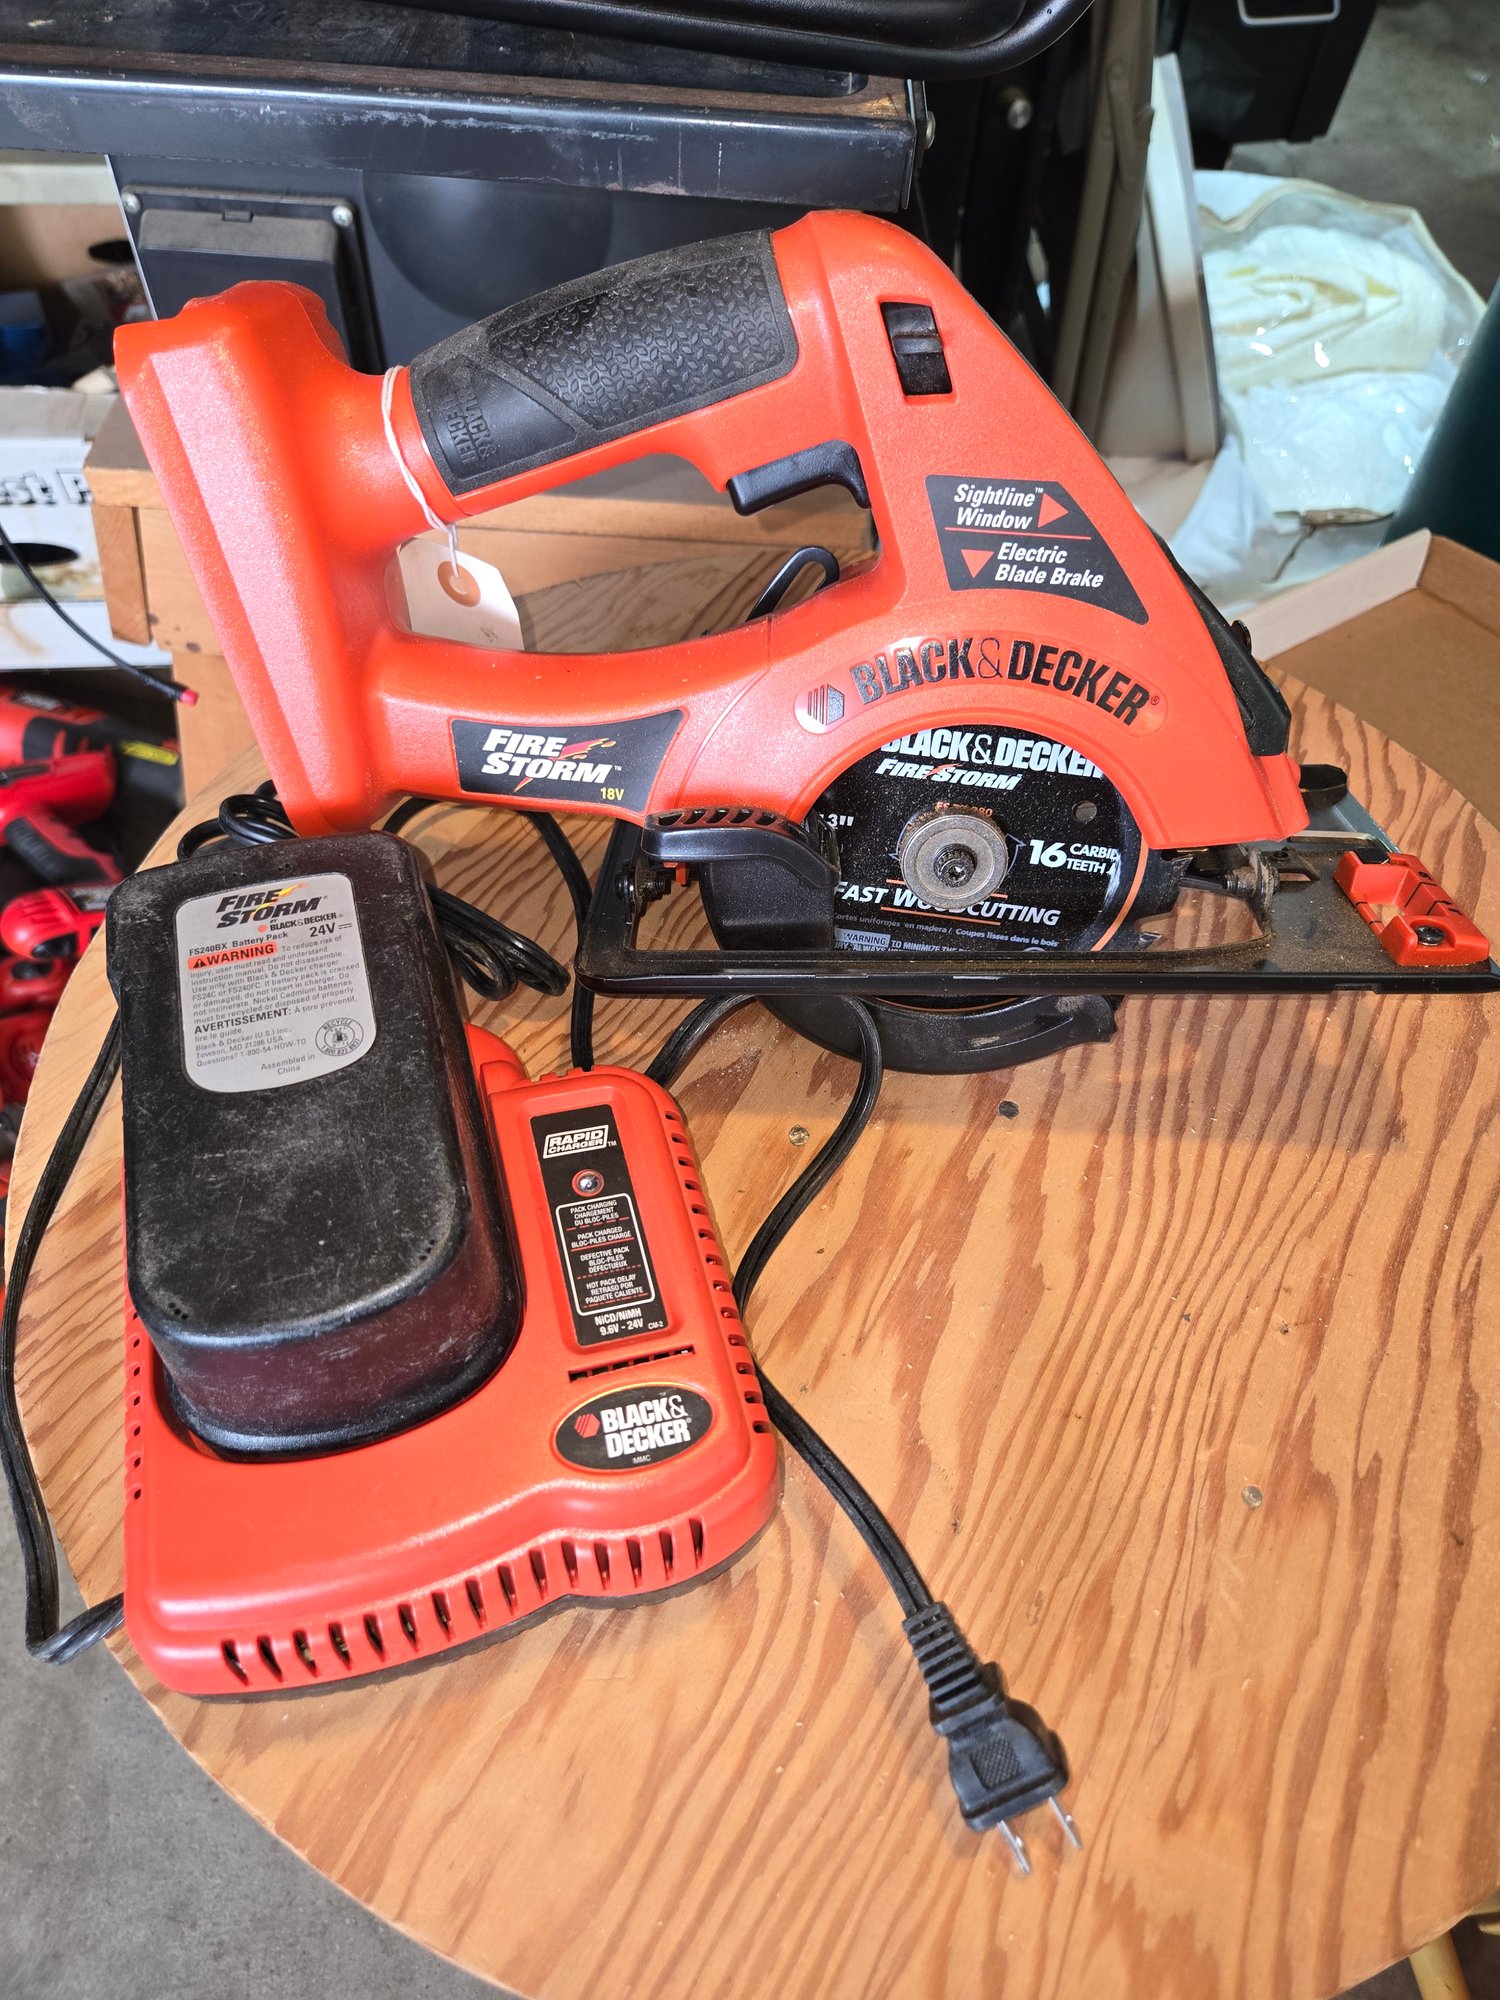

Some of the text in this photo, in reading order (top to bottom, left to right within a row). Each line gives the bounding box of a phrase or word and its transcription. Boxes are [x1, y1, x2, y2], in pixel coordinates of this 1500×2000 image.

[956, 507, 1033, 530] Window
[997, 542, 1068, 564] Electric
[995, 563, 1104, 588] Blade Brake
[482, 728, 568, 757] FIRE
[875, 758, 935, 779] FIRE
[600, 787, 625, 801] 18V
[1029, 839, 1067, 868] 16
[1066, 858, 1106, 874] TEETH
[216, 888, 282, 913] FIRE
[834, 881, 888, 904] FAST
[216, 896, 322, 929] STORM
[309, 922, 336, 938] 24V
[860, 916, 900, 927] uniformes
[916, 924, 947, 934] madera
[955, 928, 985, 938] Coupes
[987, 932, 1009, 940] lisses
[1010, 935, 1029, 944] dans
[1031, 937, 1039, 945] le
[1040, 939, 1058, 947] bois
[189, 931, 288, 956] FS240BX Battery Pack
[207, 944, 274, 966] WARNING
[293, 941, 318, 950] reduce
[320, 936, 332, 945] risk
[891, 940, 902, 949] TO
[234, 961, 252, 969] must
[254, 957, 271, 965] read
[274, 955, 286, 963] and
[288, 947, 328, 959] understand
[191, 986, 207, 994] Use
[210, 982, 226, 990] only
[228, 978, 245, 986] with
[247, 973, 269, 983] Black
[280, 966, 307, 976] Decker
[309, 960, 339, 971] charger
[191, 974, 233, 986] instruction
[192, 991, 217, 1001] FS24C
[272, 975, 299, 985] battery
[301, 970, 318, 980] pack
[329, 963, 360, 974] cracked
[271, 985, 293, 993] insert
[338, 972, 350, 980] Do
[193, 1009, 207, 1017] not
[253, 993, 278, 1004] Nickel
[280, 986, 317, 999] Cadmium
[318, 979, 352, 990] batteries
[193, 1016, 214, 1025] must
[215, 1012, 226, 1020] be
[228, 1005, 263, 1019] recycled
[275, 995, 310, 1008] disposed
[194, 1007, 292, 1034] AVERTISSEMENT:
[302, 1004, 318, 1012] titre
[194, 1034, 208, 1042] lire
[195, 1041, 217, 1051] Black
[226, 1034, 253, 1045] Decker
[229, 1044, 242, 1052] MD
[267, 1035, 283, 1044] USA
[197, 1051, 238, 1067] Questions?
[261, 1056, 306, 1071] Assembled
[277, 1066, 301, 1075] China
[548, 1139, 603, 1154] CHARGER
[549, 1129, 603, 1148] RAPID
[570, 1200, 618, 1214] PACK CHARGING
[574, 1207, 614, 1220] CHARGEMENT
[584, 1212, 619, 1224] BLOC-PILES
[594, 1226, 623, 1236] CHARGED
[571, 1237, 607, 1248] BLOC-PILES
[580, 1246, 630, 1261] DEFECTIVE PACK
[588, 1254, 625, 1267] BLOC-PILES
[586, 1274, 636, 1290] HOT PACK DELAY
[590, 1282, 633, 1296] RETRASO POR
[585, 1286, 644, 1304] PAQUETE CALIENTE
[594, 1307, 642, 1326] NiCD/NiMH
[648, 1321, 664, 1330] CM-2
[600, 1323, 619, 1336] 9.6V
[627, 1318, 644, 1330] 24V
[600, 1394, 689, 1433] BLACK&
[604, 1419, 691, 1458] DECKER
